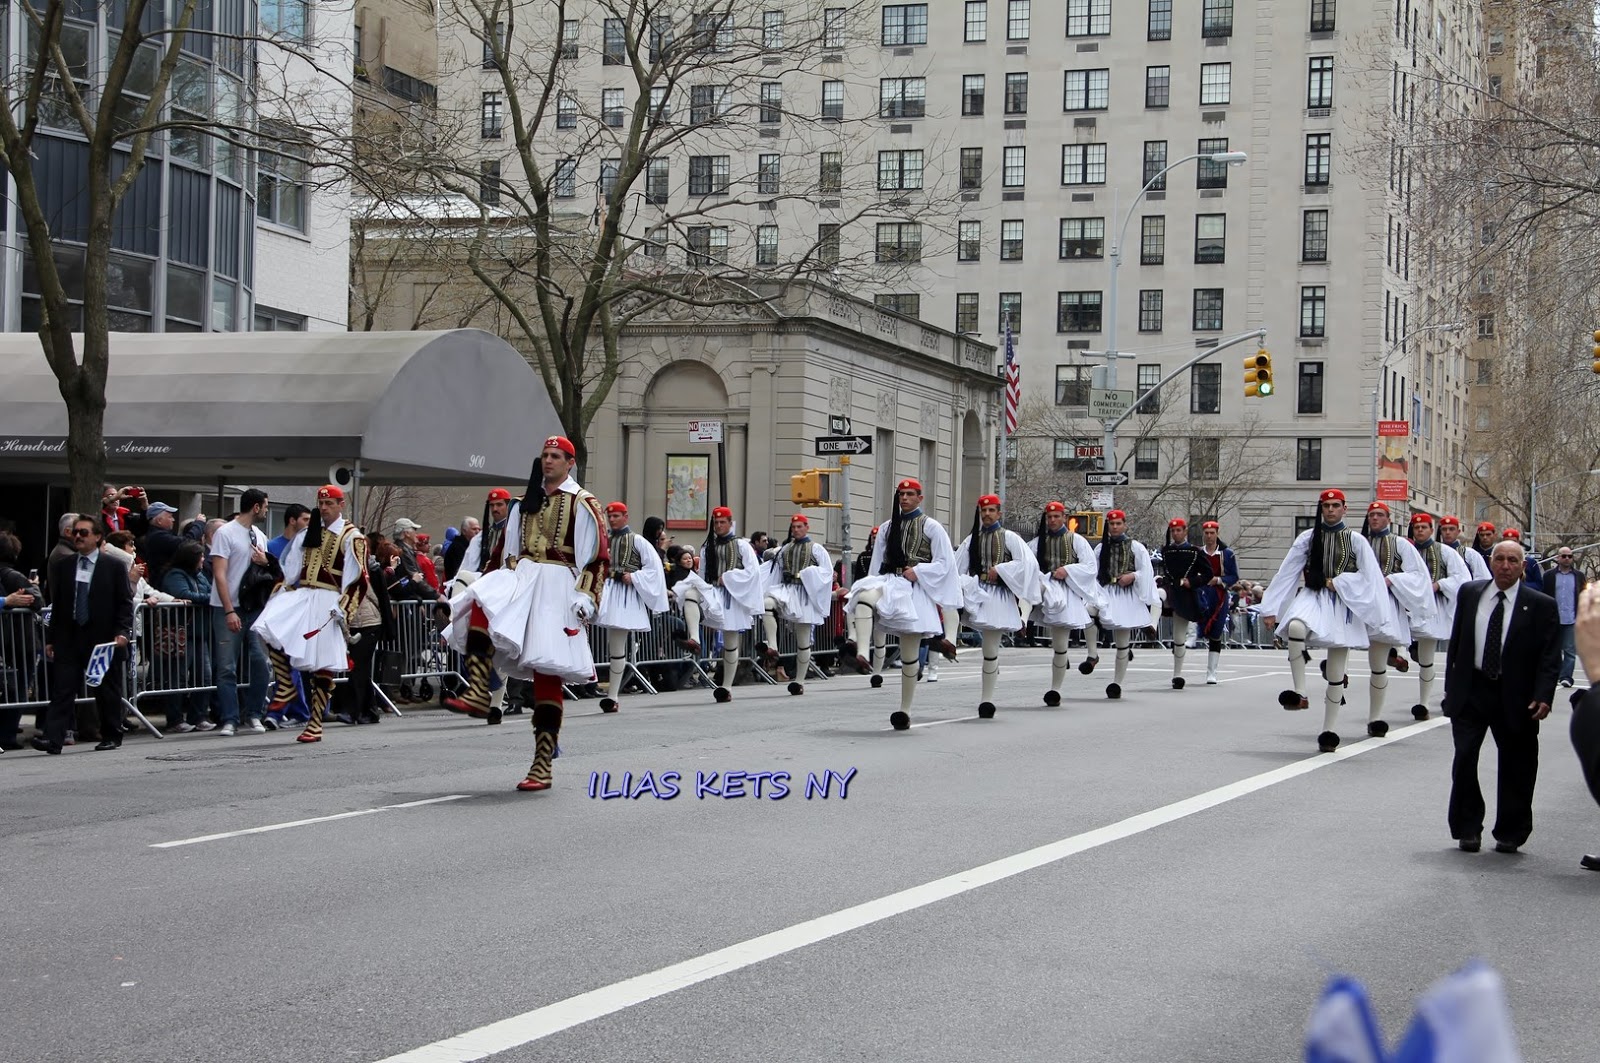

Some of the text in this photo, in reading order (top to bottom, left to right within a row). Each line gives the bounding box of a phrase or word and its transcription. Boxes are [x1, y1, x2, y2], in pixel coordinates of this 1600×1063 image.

[689, 422, 698, 430] NO
[0, 439, 66, 452] Hundred
[115, 440, 172, 453] Avenue
[823, 442, 864, 450] ONE WAY
[1076, 447, 1102, 457] E 71 ST
[469, 454, 486, 468] 900
